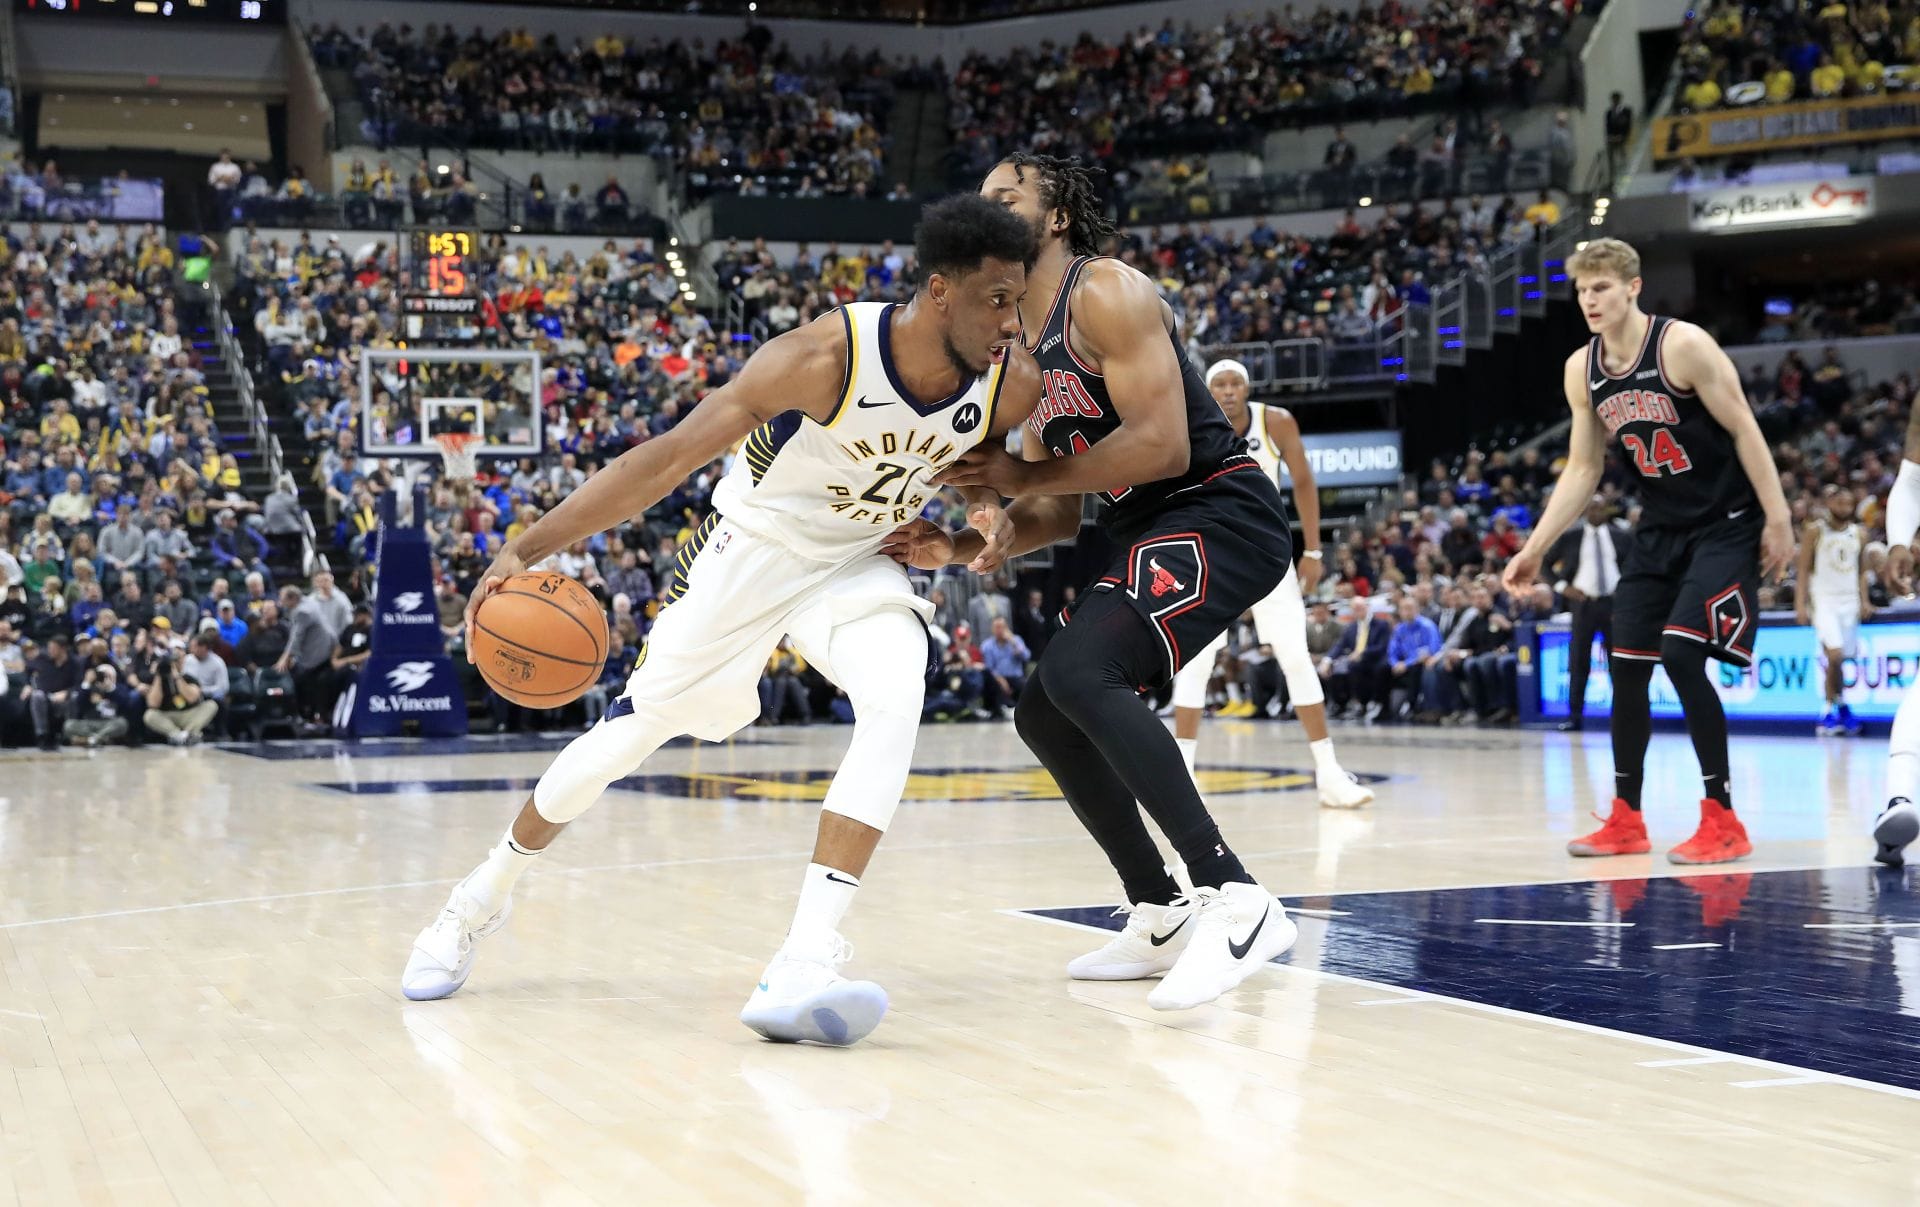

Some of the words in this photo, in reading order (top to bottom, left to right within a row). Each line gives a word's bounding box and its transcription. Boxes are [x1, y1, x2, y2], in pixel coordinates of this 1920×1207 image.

[1693, 192, 1804, 225] KeyBank
[429, 255, 465, 295] 15
[1596, 388, 1681, 436] CHICAGO
[1304, 445, 1399, 474] TBOUND
[1621, 427, 1693, 478] 24
[827, 485, 924, 525] PACERS
[396, 612, 435, 625] Vincent
[368, 694, 391, 713] St.
[389, 694, 452, 712] Vincent
